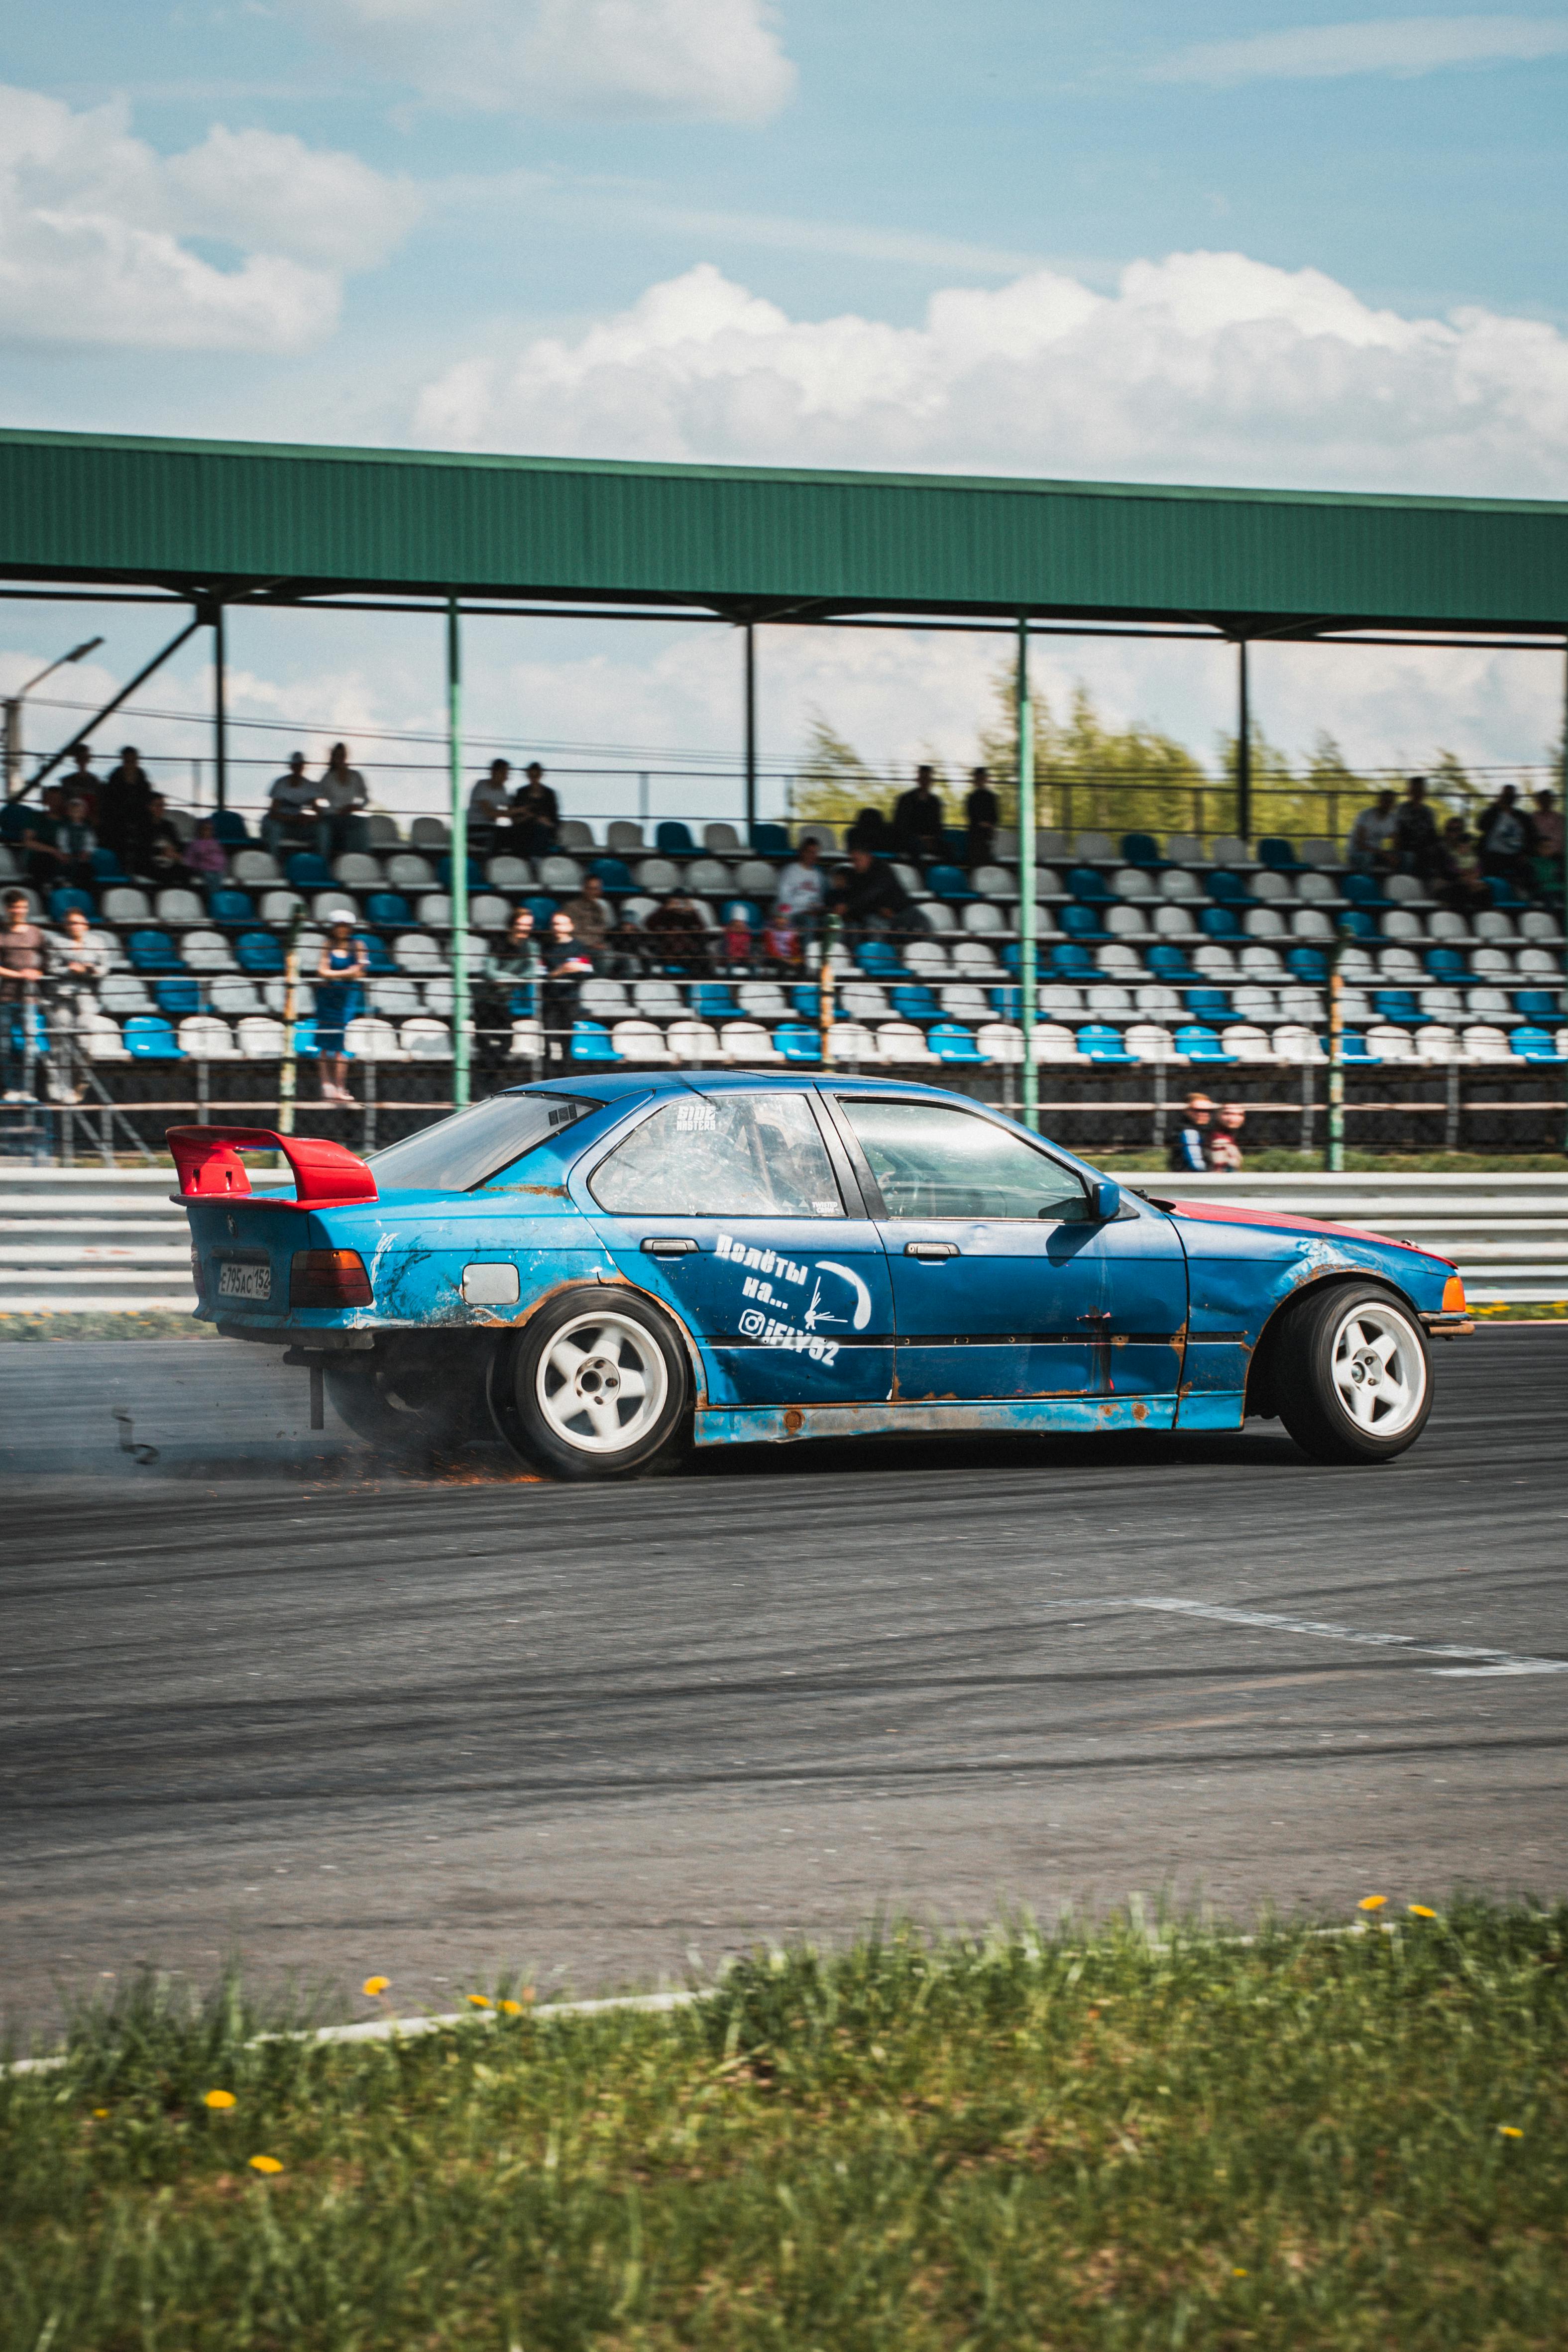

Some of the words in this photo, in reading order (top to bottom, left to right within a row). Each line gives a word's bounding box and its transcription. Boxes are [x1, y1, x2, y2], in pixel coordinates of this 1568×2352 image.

[677, 1106, 716, 1120] SIDE
[676, 1120, 716, 1131] MASTERS
[715, 1234, 808, 1285] Полёты
[254, 1269, 269, 1289] 152
